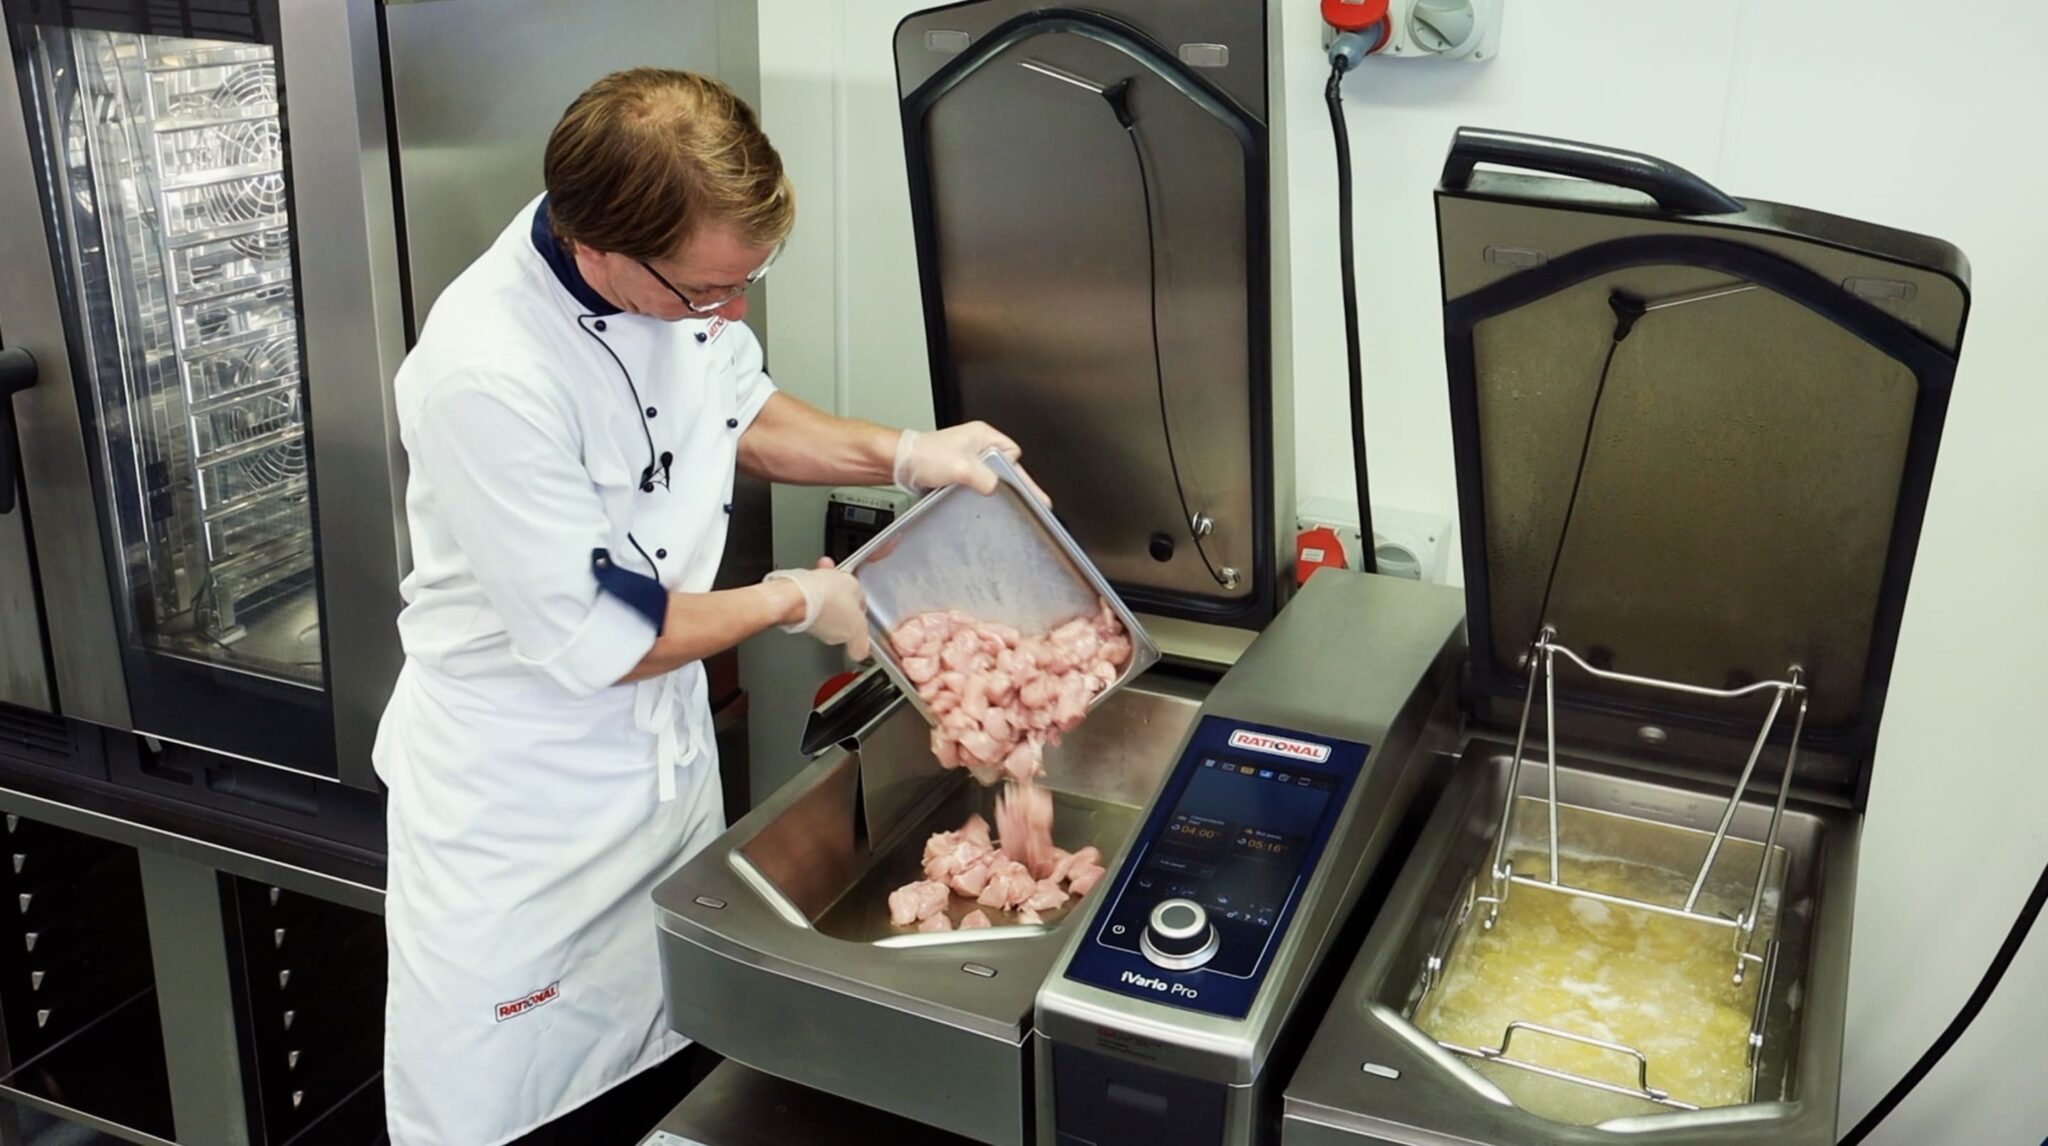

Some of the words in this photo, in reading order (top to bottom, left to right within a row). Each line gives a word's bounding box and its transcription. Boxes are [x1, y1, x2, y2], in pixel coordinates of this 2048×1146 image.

[1237, 734, 1323, 758] RATIONAL
[1120, 970, 1169, 992] iVario
[1170, 983, 1199, 999] Pro
[499, 986, 557, 1017] RATIONAL
